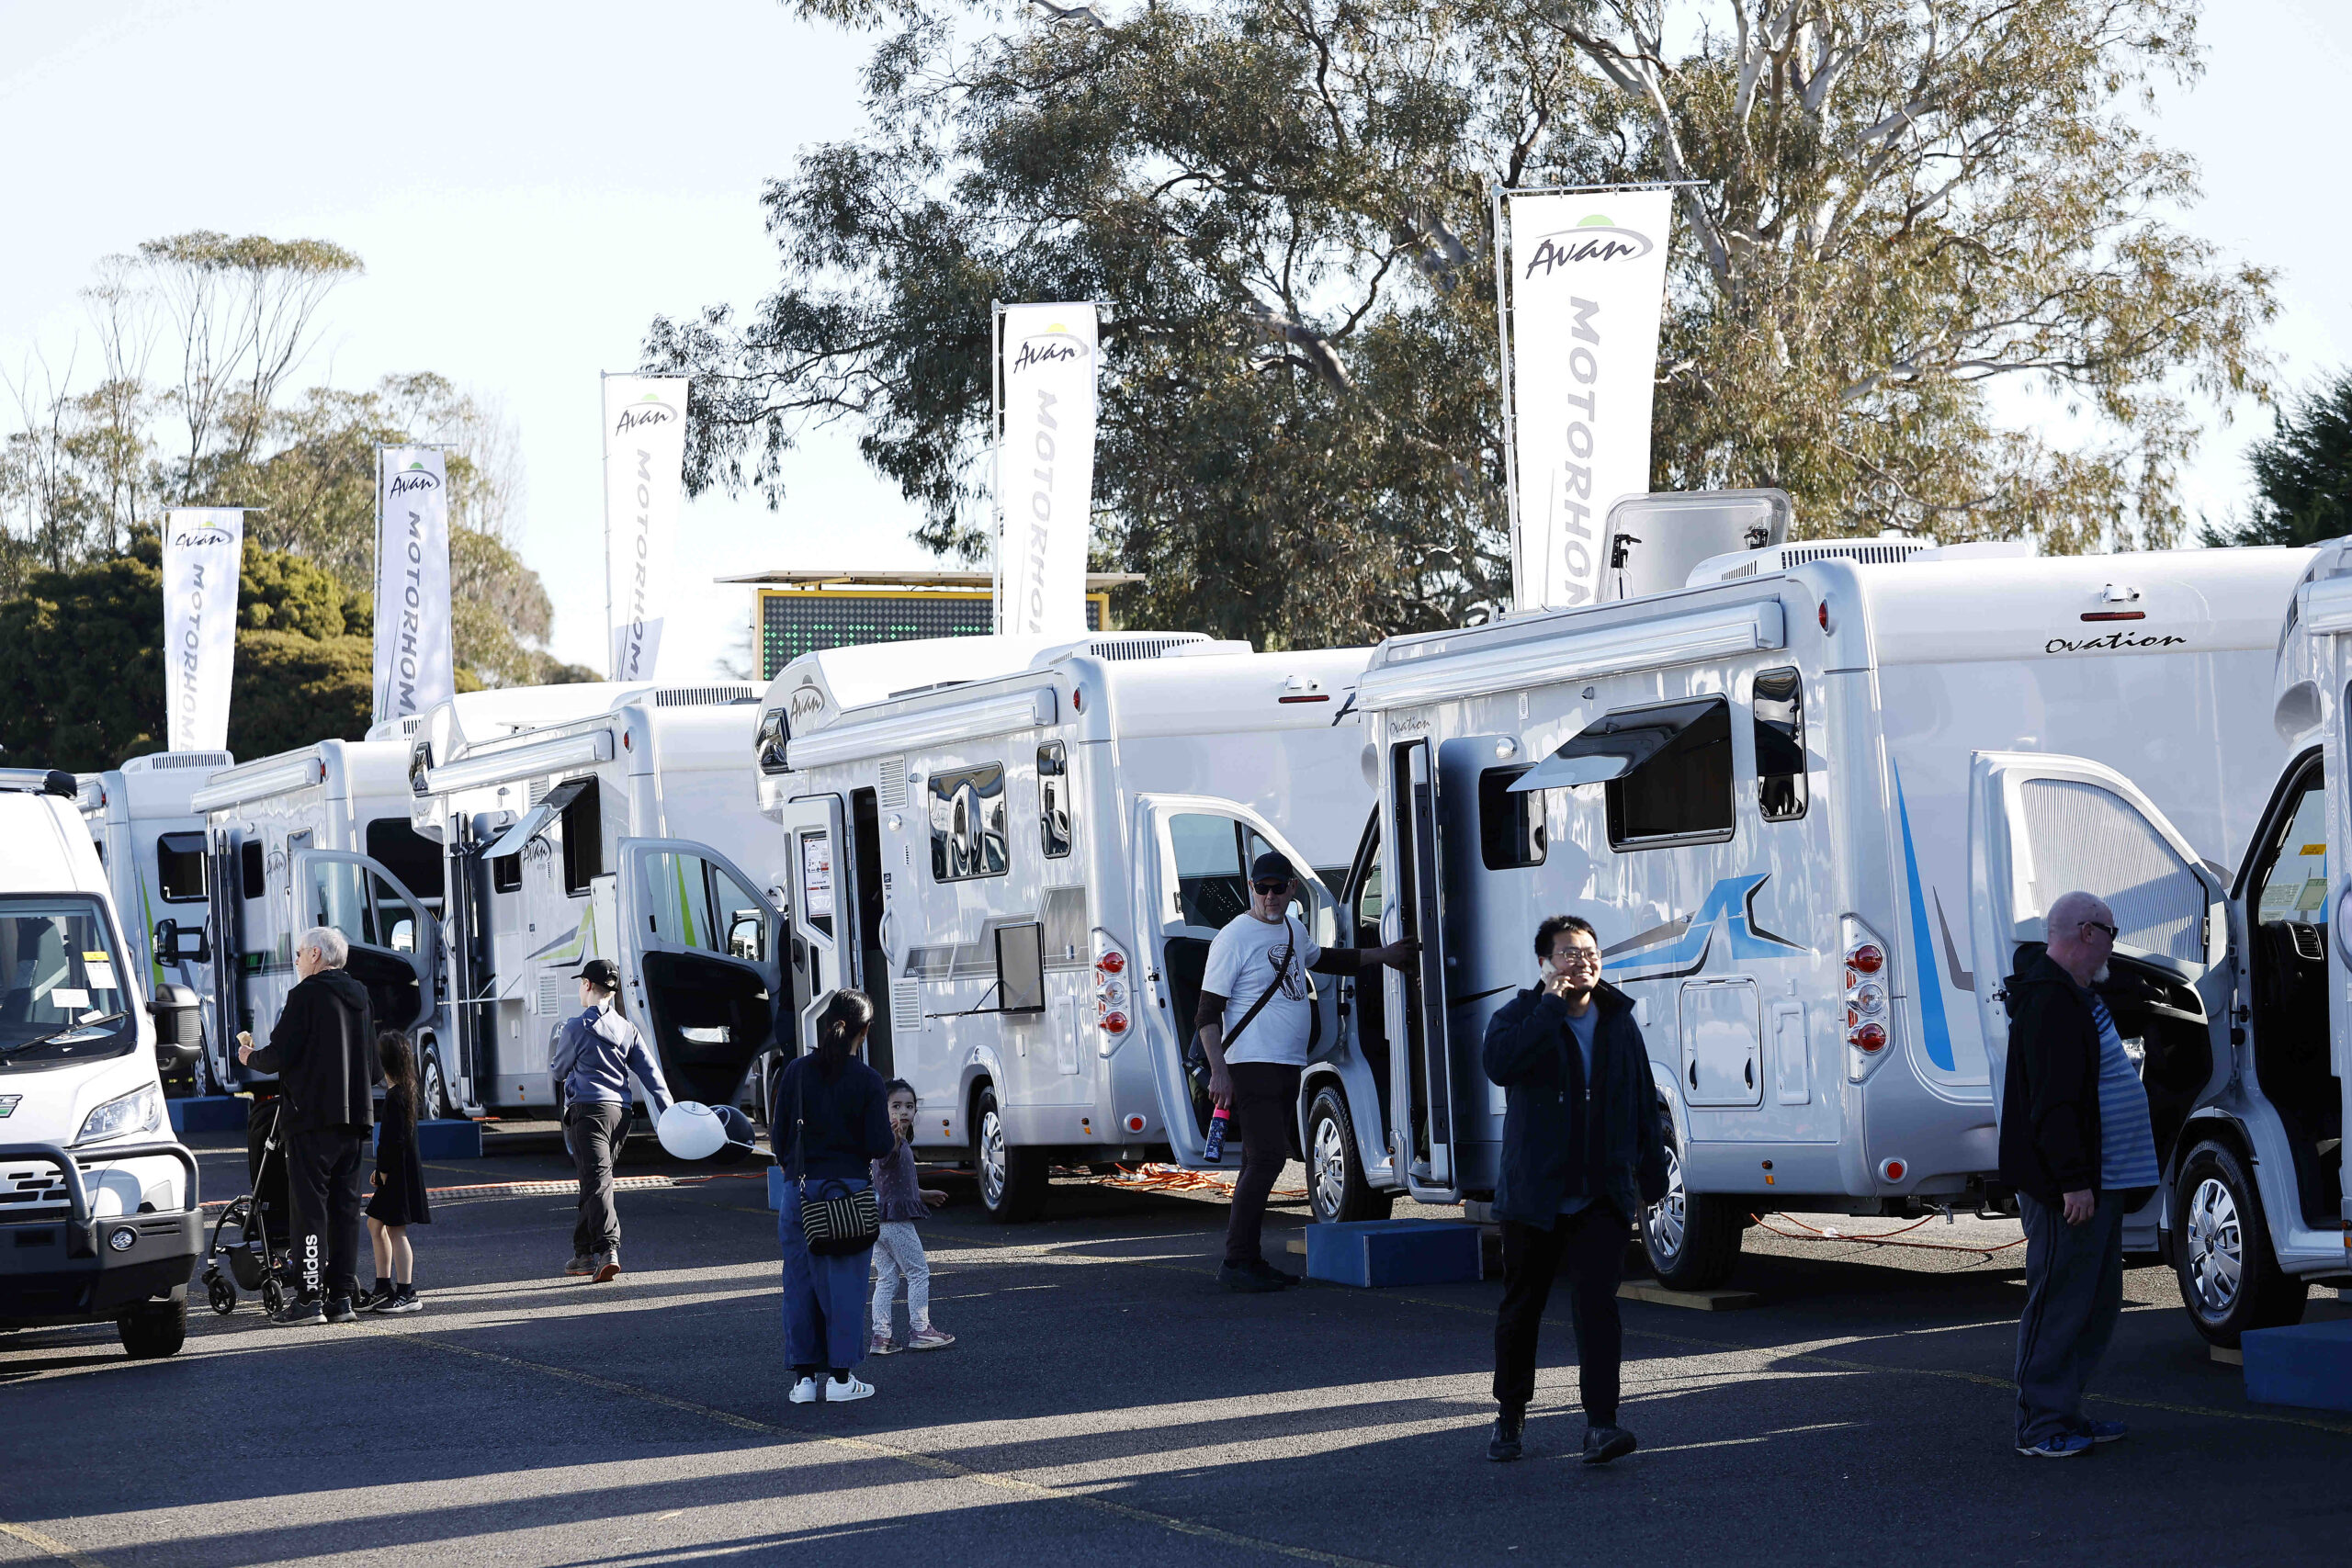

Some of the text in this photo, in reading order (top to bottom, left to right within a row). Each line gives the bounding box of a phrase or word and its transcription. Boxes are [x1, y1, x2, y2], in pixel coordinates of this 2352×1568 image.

[1526, 238, 1635, 279] Avan
[1014, 341, 1076, 374] Avan
[616, 409, 669, 436] Avan
[390, 476, 433, 500] Avan
[175, 533, 226, 551] Avan
[628, 448, 650, 682] MOTORHOM
[398, 511, 421, 717] MOTORHOM
[2045, 632, 2187, 653] Ovation
[790, 694, 820, 728] Avan
[1389, 716, 1430, 735] Ovation
[523, 844, 548, 870] Avan
